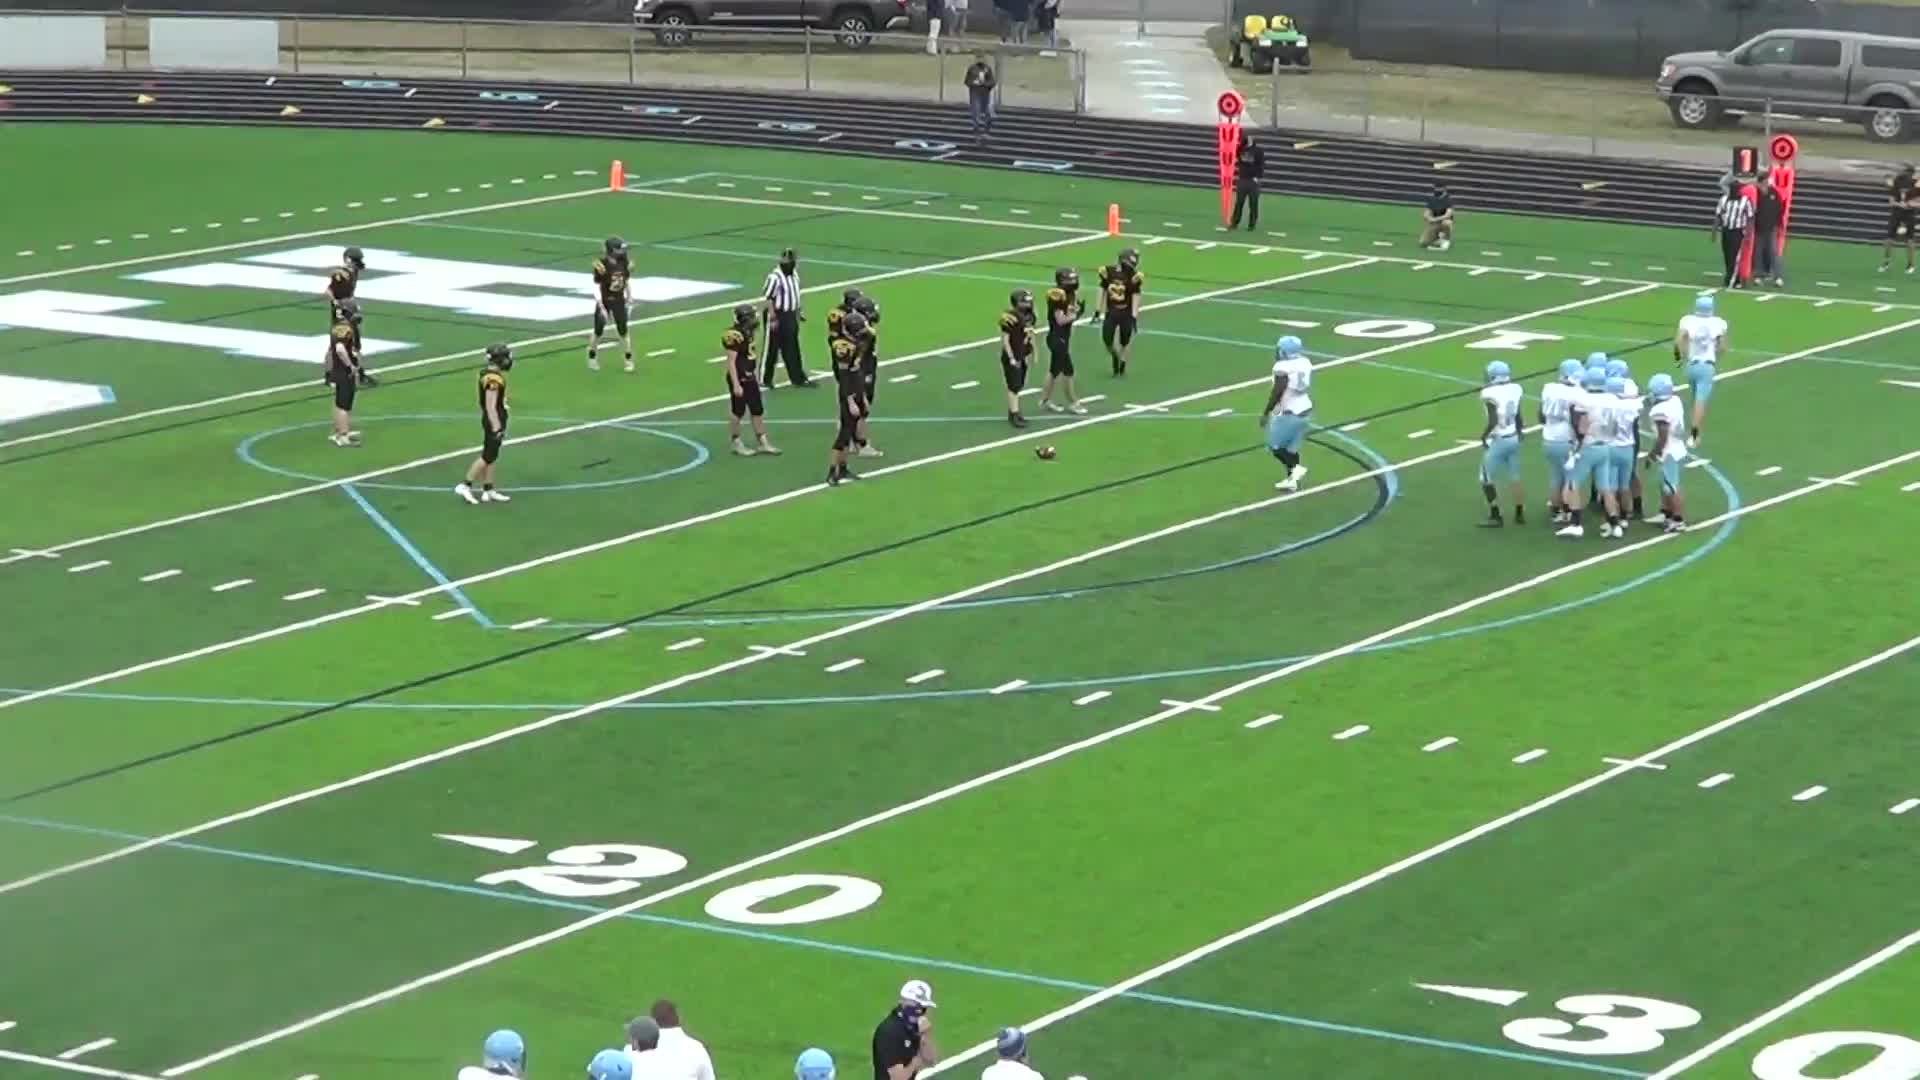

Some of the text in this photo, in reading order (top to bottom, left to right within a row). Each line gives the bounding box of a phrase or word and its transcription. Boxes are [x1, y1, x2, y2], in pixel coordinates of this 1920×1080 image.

[1740, 148, 1752, 173] 1
[475, 843, 883, 925] 20
[1501, 994, 1920, 1080] 30
